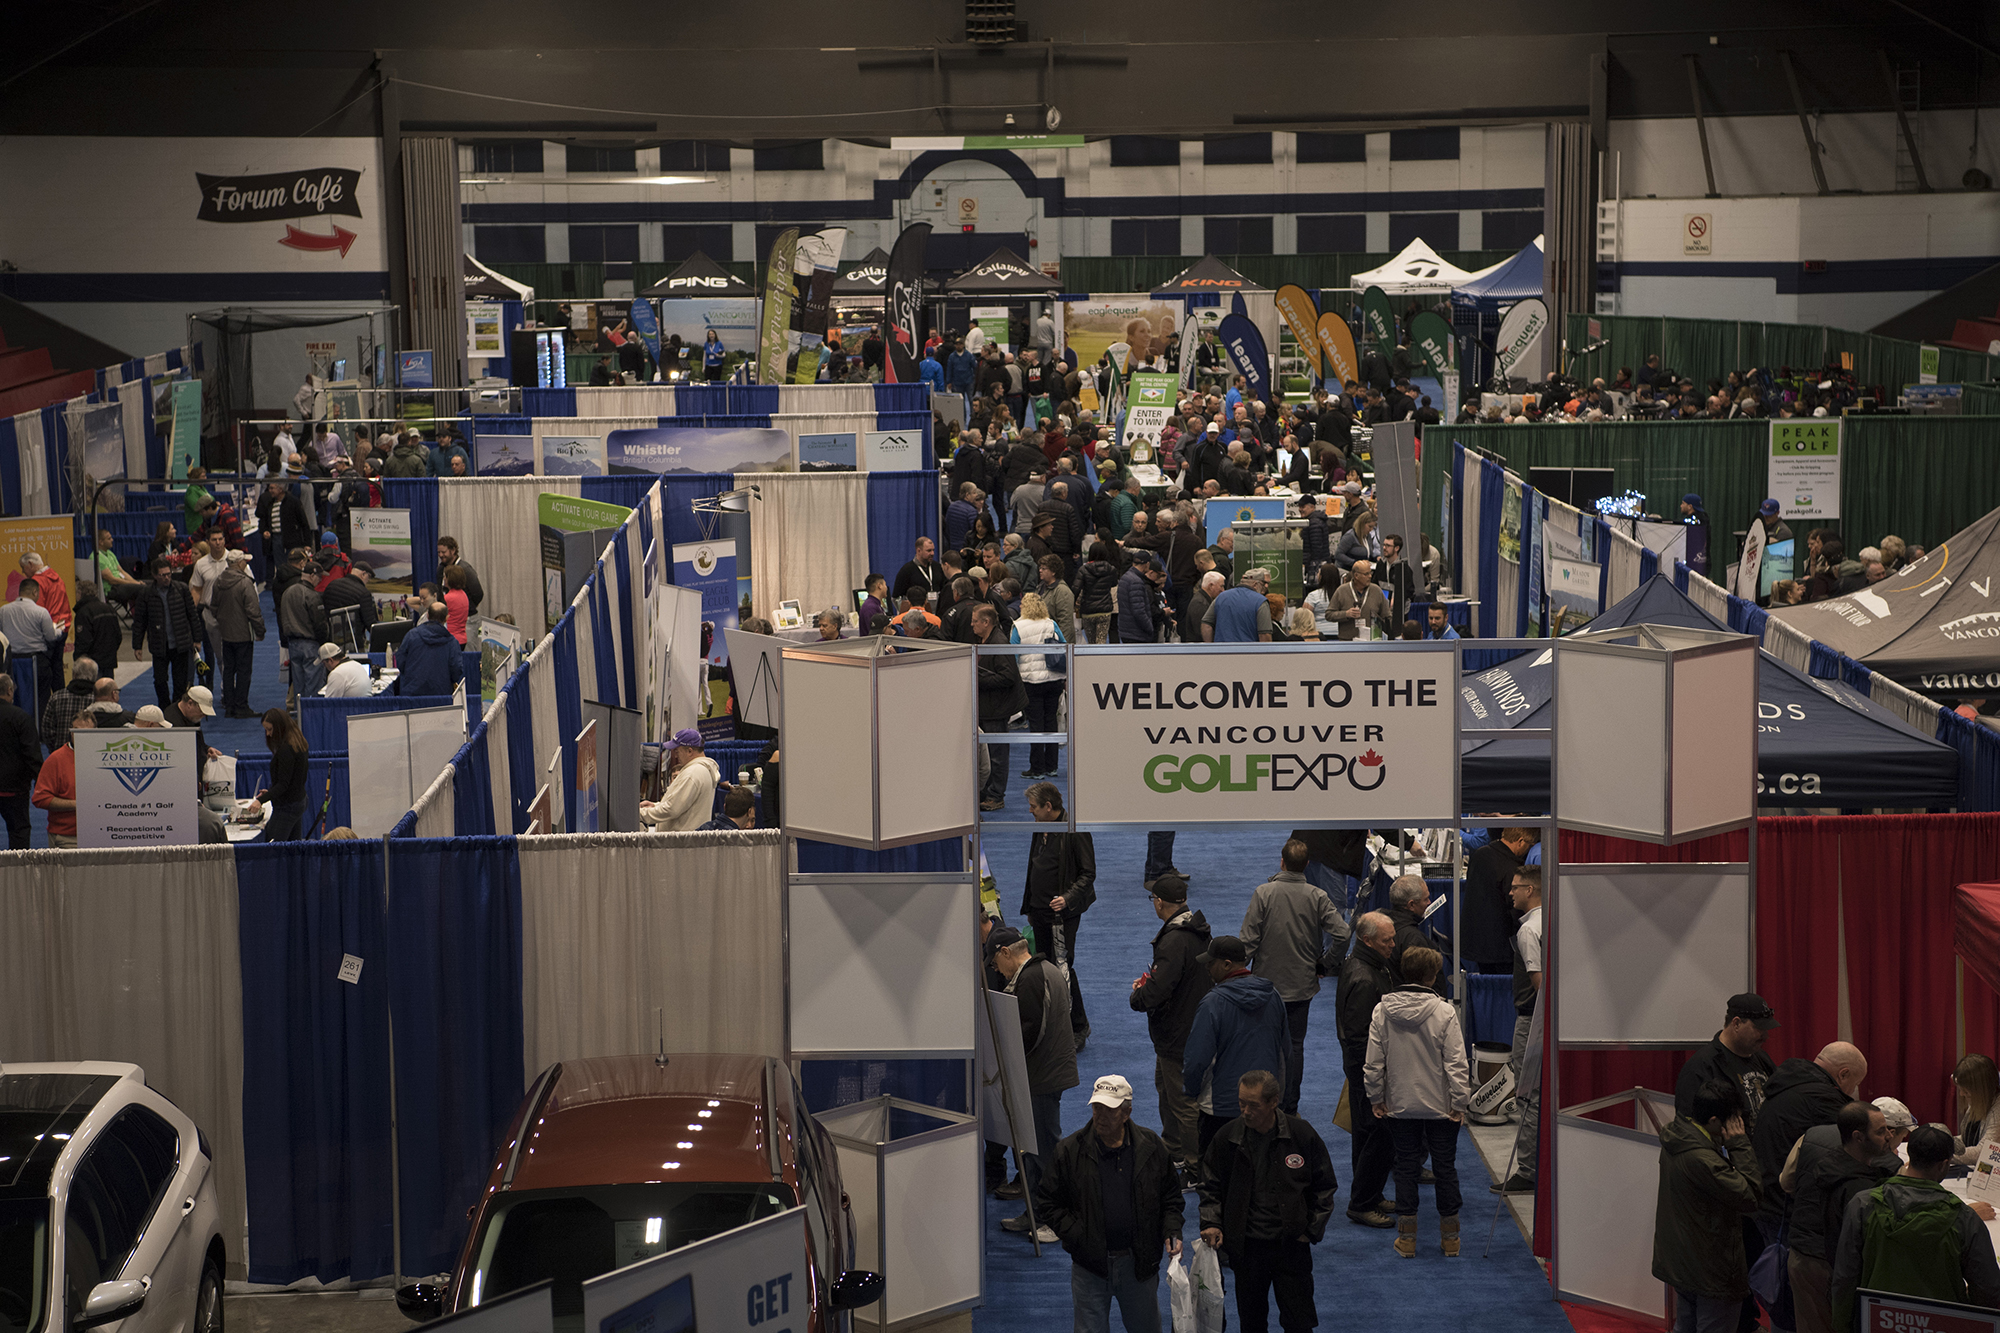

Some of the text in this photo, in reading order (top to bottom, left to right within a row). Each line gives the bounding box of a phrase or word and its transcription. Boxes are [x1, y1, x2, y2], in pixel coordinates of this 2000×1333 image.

[211, 174, 344, 212] Forum Café
[846, 266, 887, 281] Calla
[976, 263, 1030, 277] Callaway
[669, 276, 729, 289] PING
[1180, 278, 1242, 287] KING
[806, 302, 825, 311] FALLS
[900, 286, 913, 334] PGA
[1088, 306, 1139, 318] eaglequest
[1278, 296, 1318, 358] practice
[1370, 309, 1389, 340] play
[1230, 337, 1261, 384] learn
[1318, 327, 1352, 383] practic
[1421, 337, 1451, 374] play
[1136, 409, 1163, 417] ENTER
[1133, 417, 1165, 426] TO WIN!
[1782, 427, 1829, 437] PEAK
[622, 444, 682, 456] Whistler
[1782, 441, 1829, 451] GOLF
[622, 456, 682, 464] British Columbia
[551, 502, 619, 524] ACTIVATE YOUR GAME
[1, 540, 69, 554] SHEN YUN
[1571, 566, 1590, 578] MEADOW
[705, 585, 729, 597] EAGLE
[707, 596, 730, 607] CLUB
[1849, 611, 1872, 628] TOUR
[1944, 626, 2000, 641] VANCO
[1092, 679, 1437, 710] WELCOME TO THE
[1144, 724, 1385, 745] VANCOUVER
[101, 752, 172, 762] ZONE GOLF
[1143, 750, 1386, 794] GOLFEXPO
[206, 785, 229, 793] PGA
[344, 960, 360, 971] 261
[1475, 1073, 1507, 1107] Cleveland
[747, 1272, 793, 1327] GET
[1879, 1309, 1931, 1330] SHOW
